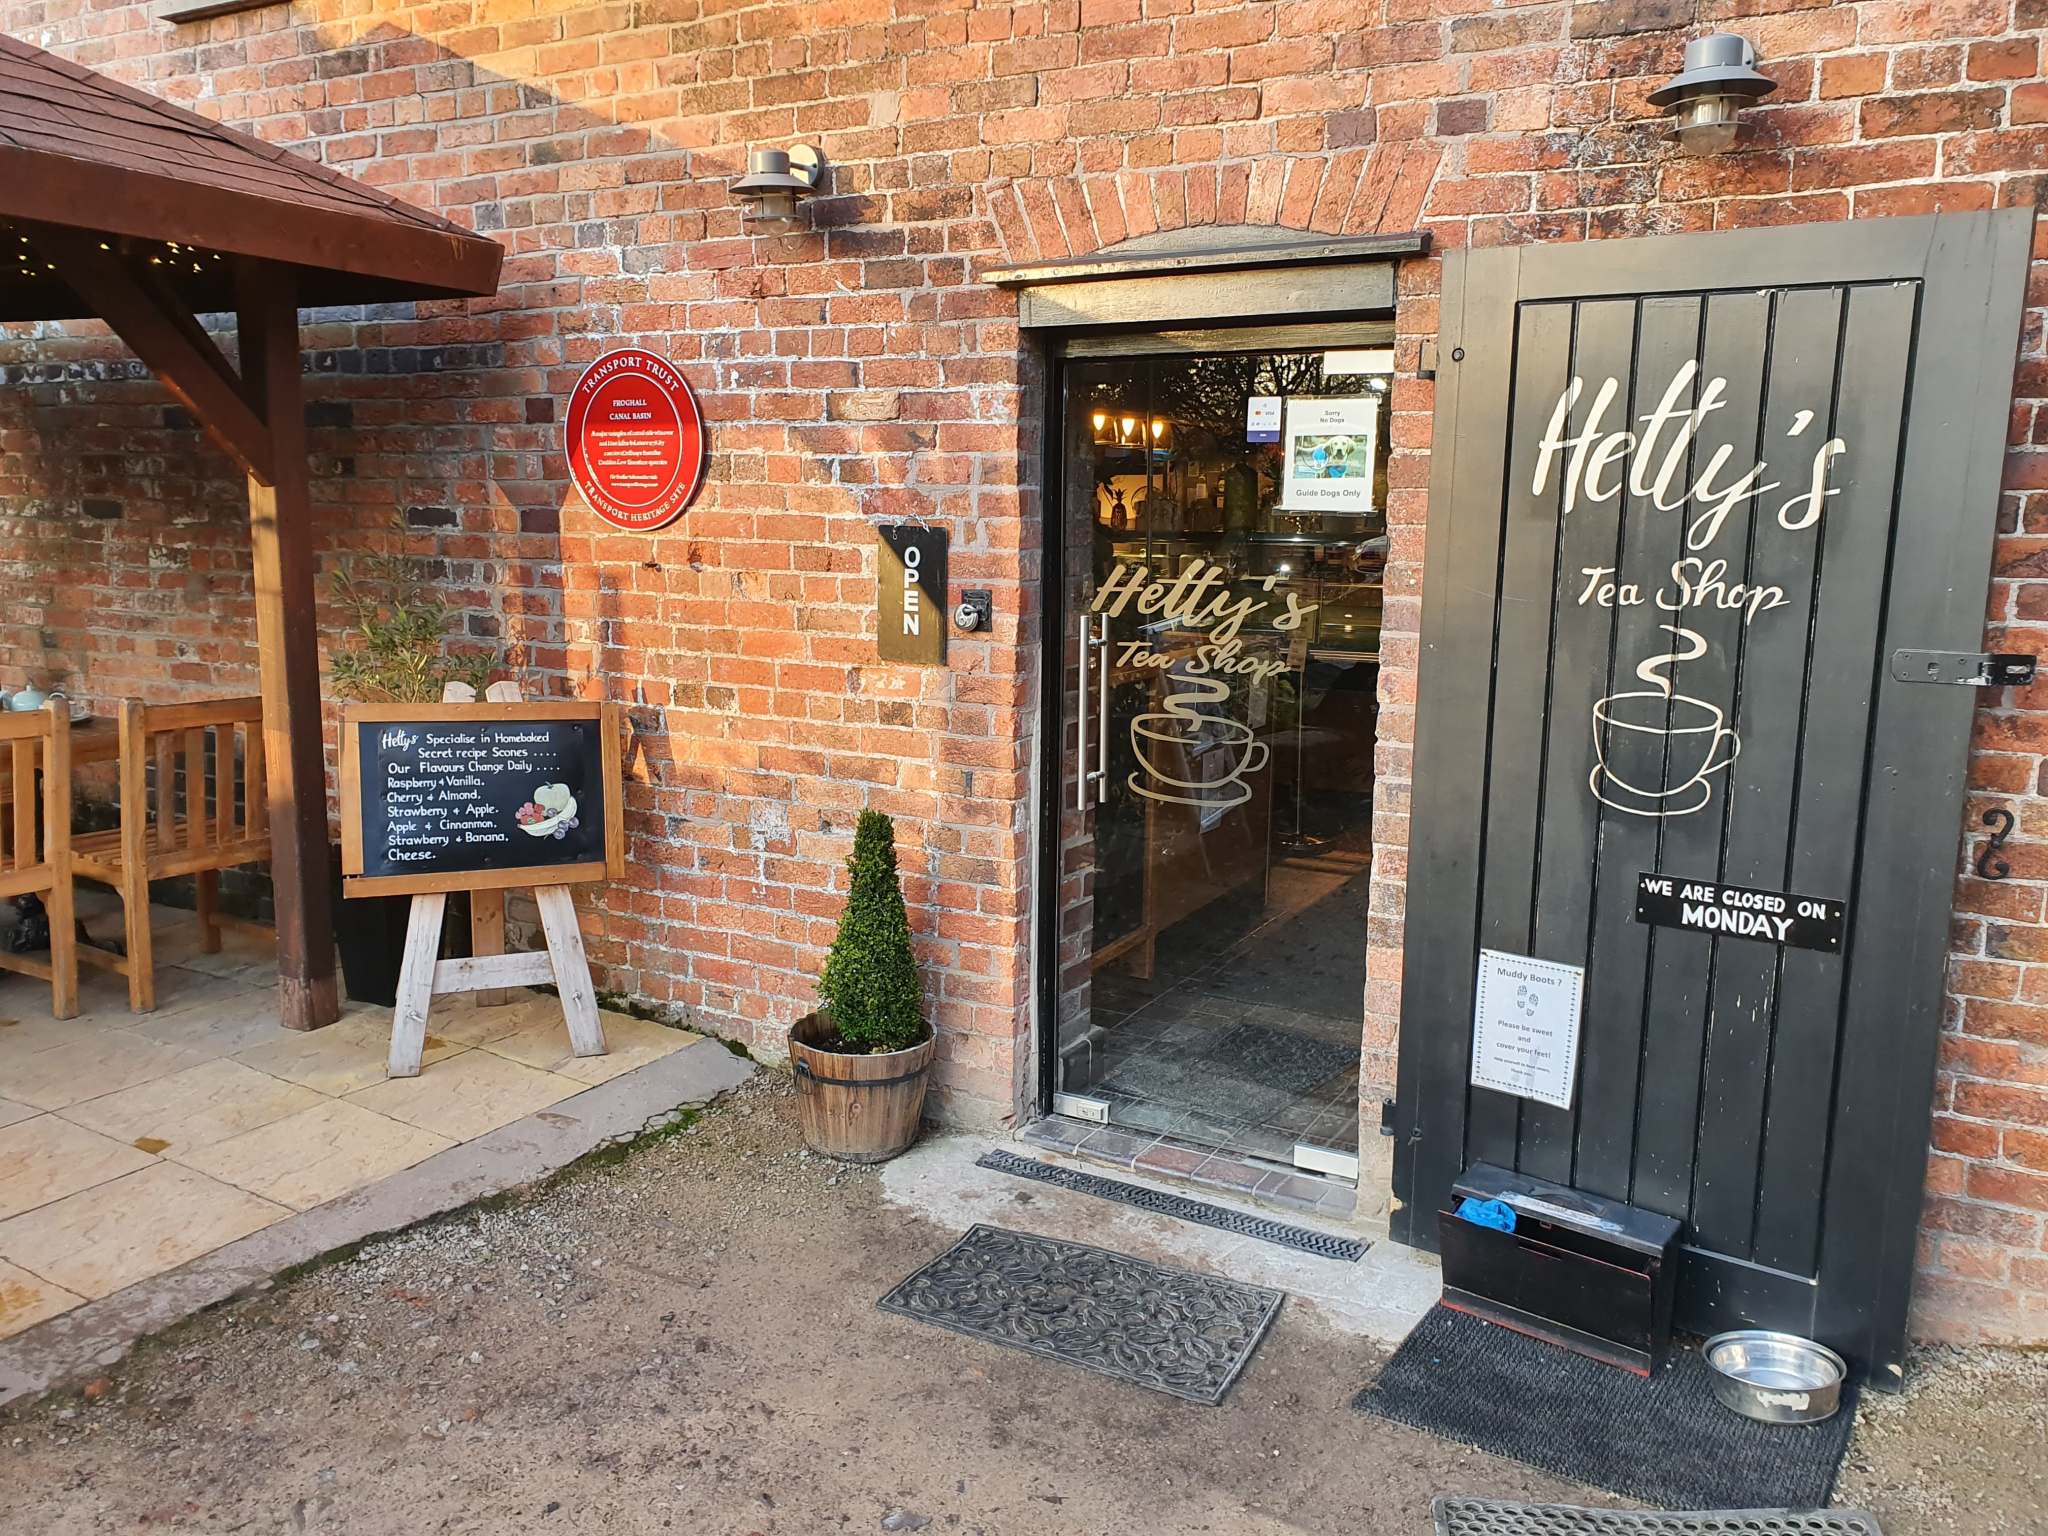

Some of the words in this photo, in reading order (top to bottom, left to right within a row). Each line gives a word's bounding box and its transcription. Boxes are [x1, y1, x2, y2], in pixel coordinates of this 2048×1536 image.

[582, 357, 642, 394] TRANSPORT
[646, 361, 680, 391] TRUST
[612, 399, 647, 407] FROGHALL
[609, 412, 632, 421] CANAL
[633, 412, 652, 420] BASIN
[1532, 359, 1846, 551] Hetty's
[584, 480, 629, 521] TRANSPORT
[631, 502, 671, 522] HERITAGE
[670, 482, 686, 504] SITE
[1296, 489, 1319, 497] Guide
[1320, 489, 1341, 498] Dogs
[1342, 489, 1361, 498] Only
[903, 546, 921, 636] OPEN
[1578, 567, 1645, 607] Tea
[1656, 557, 1791, 626] Shop
[1091, 559, 1319, 645] Hetty's
[1116, 640, 1175, 668] Tea
[1186, 639, 1291, 687] Shop
[426, 733, 476, 747] Specialise
[480, 733, 491, 743] in
[495, 731, 550, 743] Homebaked
[418, 747, 454, 758] Secret
[456, 748, 488, 760] recipe
[492, 747, 529, 757] Scones
[388, 762, 411, 774] Our
[420, 762, 465, 773] Flavours
[468, 761, 504, 774] Change
[507, 760, 533, 773] Daily
[387, 777, 437, 791] Raspberry
[387, 792, 423, 805] Cherry
[439, 789, 481, 801] Almond.
[387, 805, 448, 819] Strawberry
[466, 803, 500, 818] Apple.
[387, 821, 417, 834] Apple
[388, 834, 449, 847] Strawberry
[466, 831, 509, 843] Banana.
[388, 848, 437, 861] Cheese.
[1645, 878, 1673, 897] WE
[1680, 884, 1715, 903] ARE
[1722, 890, 1786, 913] CLOSED
[1797, 901, 1827, 920] ON
[1681, 903, 1794, 942] MONDAY
[1497, 967, 1528, 981] Muddy
[1530, 974, 1555, 986] Boots
[1498, 1019, 1520, 1030] Please
[1521, 1024, 1530, 1032] be
[1496, 1042, 1516, 1050] cover
[1516, 1046, 1533, 1055] your
